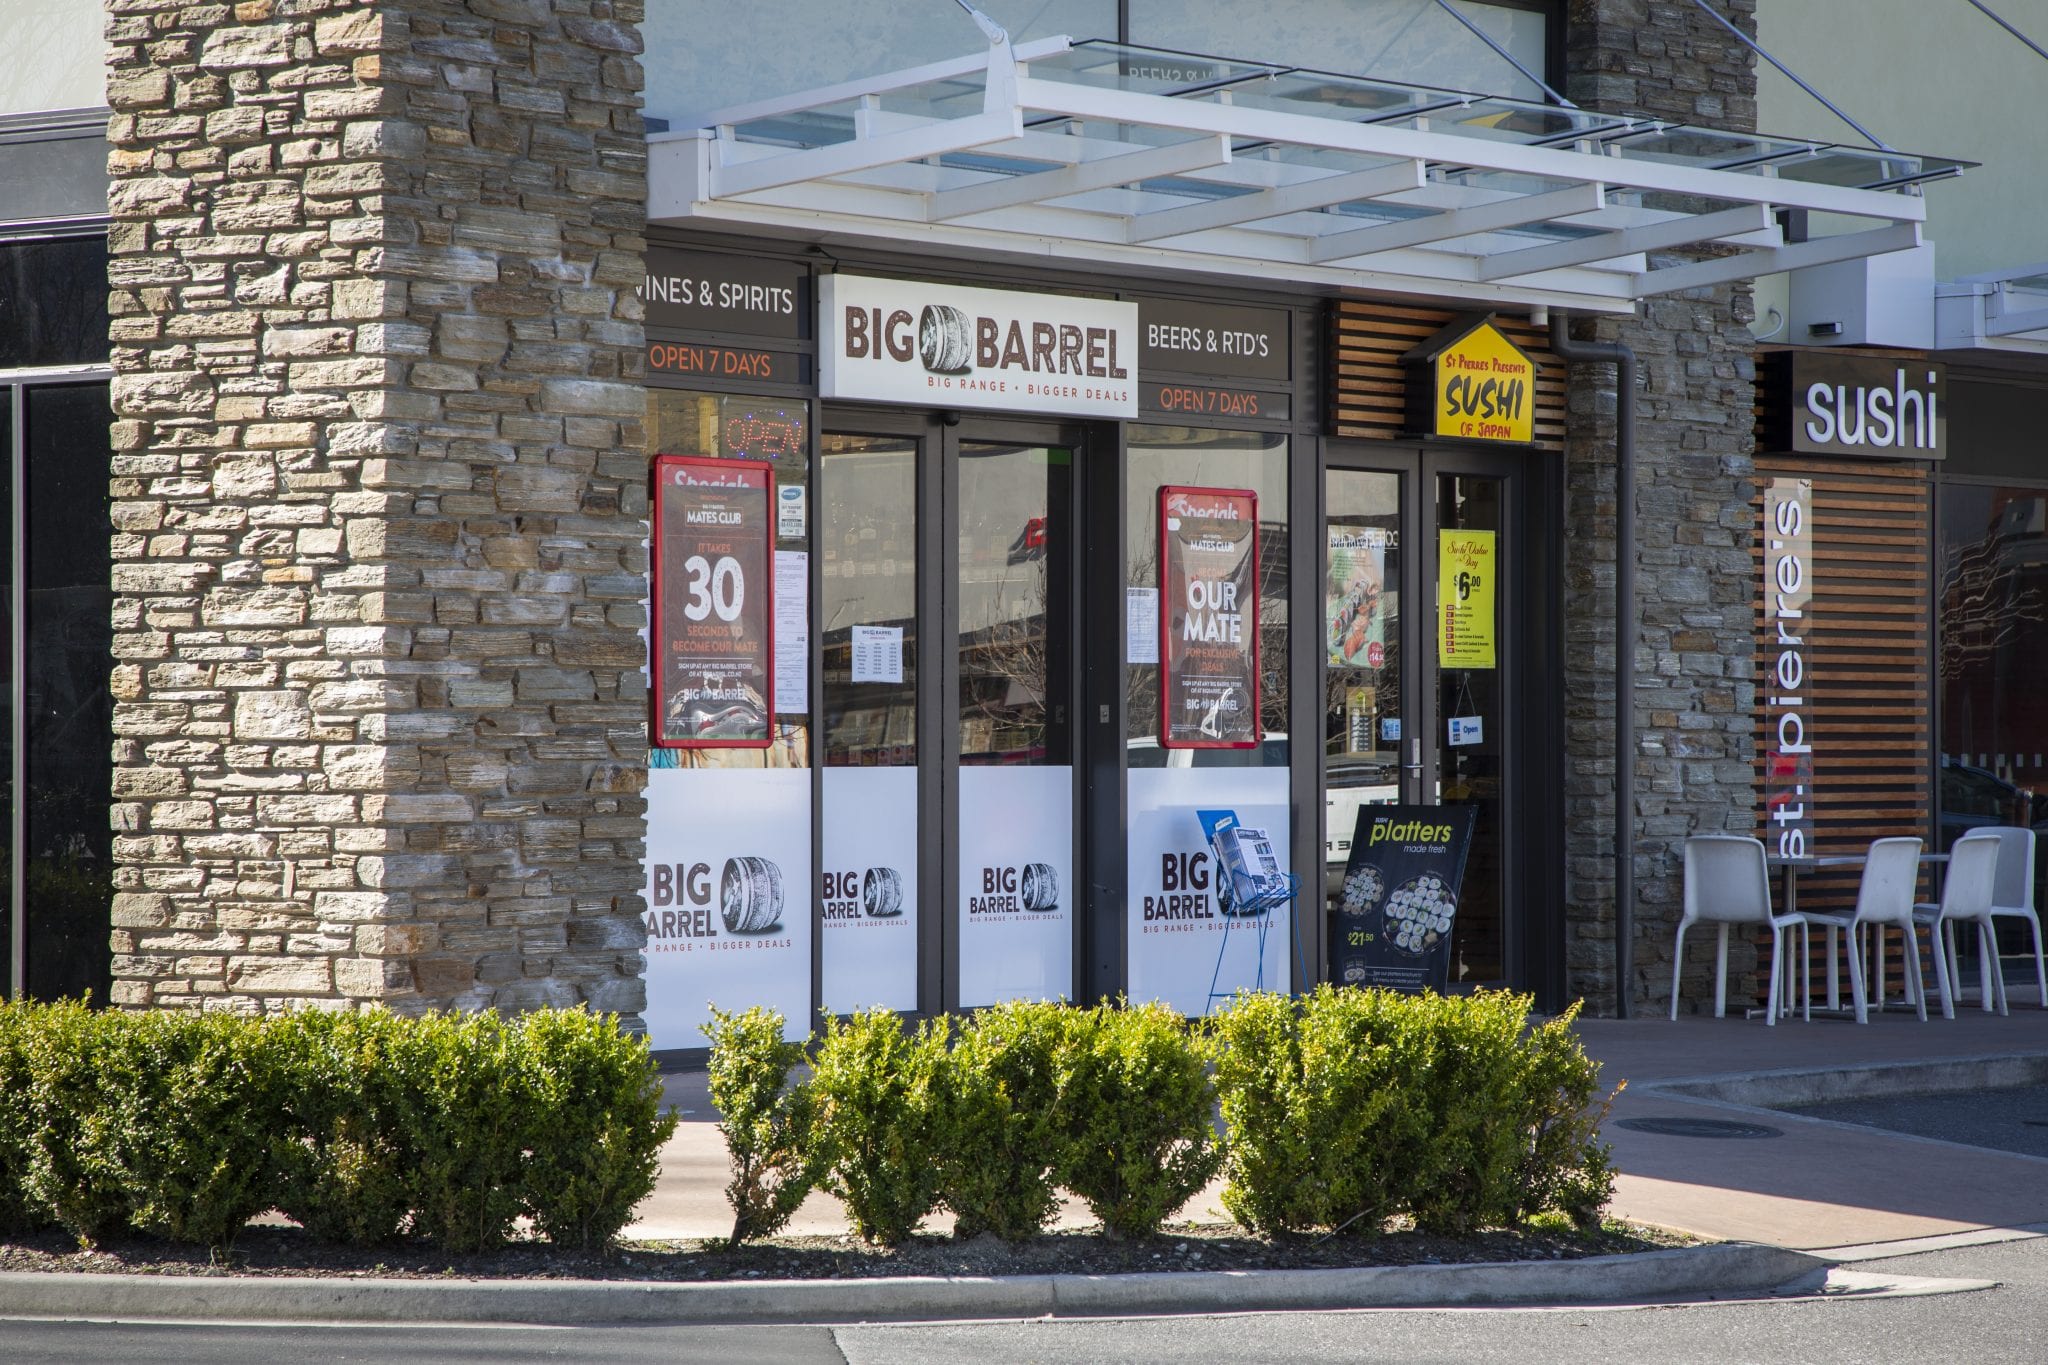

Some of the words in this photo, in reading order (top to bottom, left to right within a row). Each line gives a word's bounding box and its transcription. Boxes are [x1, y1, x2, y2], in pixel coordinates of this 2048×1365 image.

[636, 275, 693, 304] INES
[700, 280, 713, 306] &
[719, 282, 793, 314] SPIRITS
[845, 305, 914, 363] BIG
[976, 316, 1128, 379] BARREL
[1148, 324, 1201, 351] BEERS
[1206, 329, 1217, 352] &
[1223, 331, 1268, 357] RTD'S
[650, 345, 704, 371] OPEN
[709, 350, 719, 372] 7
[724, 351, 771, 377] DAYS
[928, 376, 951, 388] BIG
[960, 379, 1006, 392] RANGE
[1028, 384, 1077, 398] BIGGER
[1086, 389, 1128, 401] DEALS
[1160, 387, 1204, 412] OPEN
[1208, 391, 1216, 411] 7
[1220, 392, 1258, 415] DAYS
[1445, 374, 1524, 421] SUSHI
[1805, 368, 1936, 449] sushi
[727, 418, 802, 454] OPEN
[1460, 421, 1473, 436] OF
[1478, 421, 1511, 438] JAPAN
[686, 511, 717, 524] MATES
[718, 512, 742, 525] CLUB
[684, 555, 745, 622] 30
[1188, 580, 1237, 611] OUR
[1454, 571, 1481, 601] $6.00
[687, 625, 729, 637] SECONDS
[730, 626, 744, 637] TO
[1184, 611, 1242, 642] MATE
[1770, 500, 1811, 752] pierre's
[672, 641, 710, 652] BECOME
[711, 641, 732, 652] OUR
[734, 641, 758, 653] MATE
[1186, 699, 1200, 710] BIG
[1463, 725, 1479, 736] Open
[1369, 820, 1453, 847] platters
[1403, 845, 1427, 853] made
[1427, 845, 1447, 853] fresh
[653, 863, 711, 906] BIG
[822, 871, 858, 899] BIG
[983, 867, 1017, 893] BIG
[1162, 852, 1209, 891] BIG
[822, 901, 861, 919] ARREL
[970, 896, 1020, 913] BARREL
[1143, 894, 1214, 920] BARREL
[645, 910, 717, 939] ARREL
[1143, 925, 1159, 933] BIG
[1164, 924, 1194, 932] RANGE
[1347, 931, 1374, 946] $21.50
[655, 943, 692, 953] RANGE
[710, 940, 751, 951] BIGGER
[757, 939, 791, 948] DEALS
